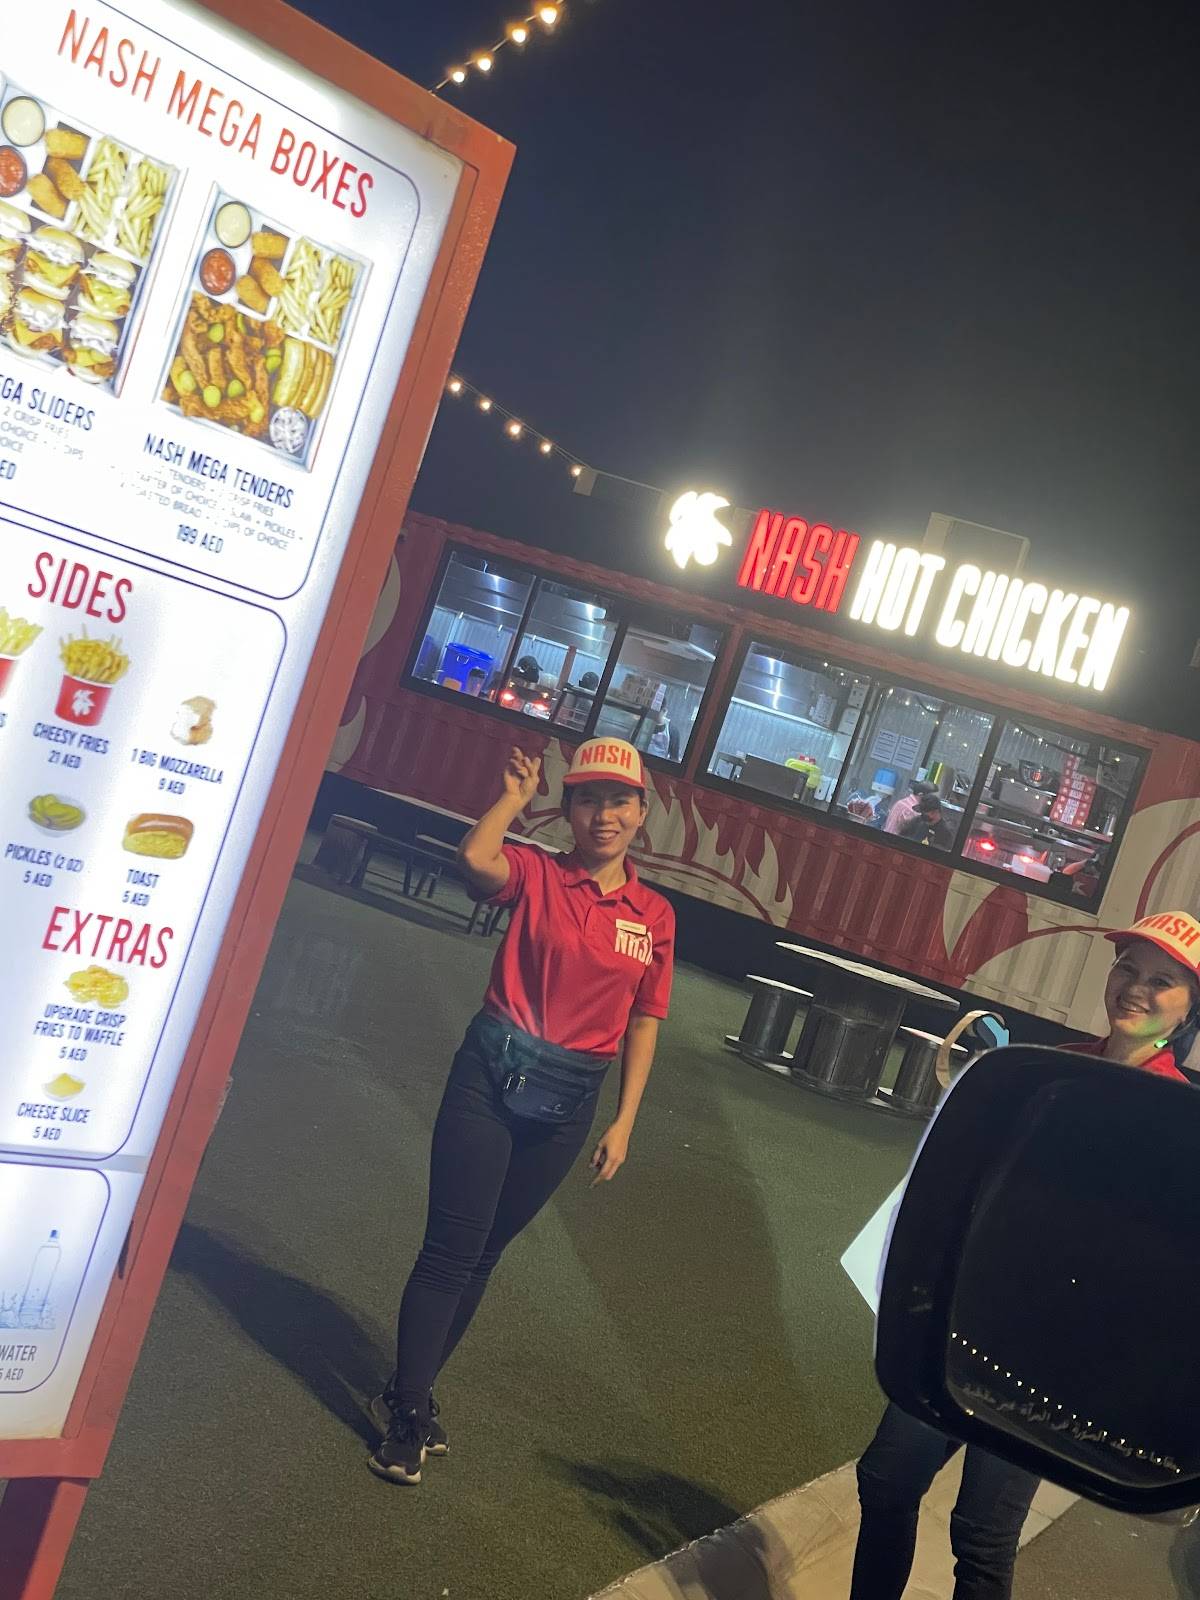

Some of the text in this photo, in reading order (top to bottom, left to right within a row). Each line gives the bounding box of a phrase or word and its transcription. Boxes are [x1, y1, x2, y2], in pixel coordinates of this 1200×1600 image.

[58, 9, 374, 219] NASH MEGA BOXES
[0, 374, 96, 431] GA SLIDERS
[143, 433, 294, 508] NASH MEGA TENDERS
[253, 501, 274, 517] FRIES
[176, 523, 224, 553] 199 AED
[257, 531, 288, 550] CHOICE
[264, 520, 296, 539] PICKLES
[27, 551, 133, 623] SIDES
[737, 508, 1131, 692] NASH HOT CHICKEN
[33, 722, 110, 755] CHEESY FRIES
[48, 750, 82, 769] 21 AED
[131, 748, 223, 784] 1 BIG MOZZARELLA
[580, 744, 632, 770] NASH
[167, 779, 187, 795] AED
[4, 843, 52, 866] PICKLES
[53, 853, 65, 869] (2
[23, 870, 53, 887] 5 AED
[126, 868, 161, 888] TOAST
[121, 890, 151, 907] 5 AED
[41, 906, 174, 969] EXTRAS
[44, 1003, 128, 1028] UPGRADE CRISP
[33, 1020, 125, 1047] FRIES TO WAFFLE
[58, 1046, 88, 1062] 5 AED
[17, 1102, 90, 1123] CHEESE SLICE
[32, 1127, 61, 1141] 5 AED
[0, 1344, 37, 1361] WATER
[4, 1367, 24, 1381] AED
